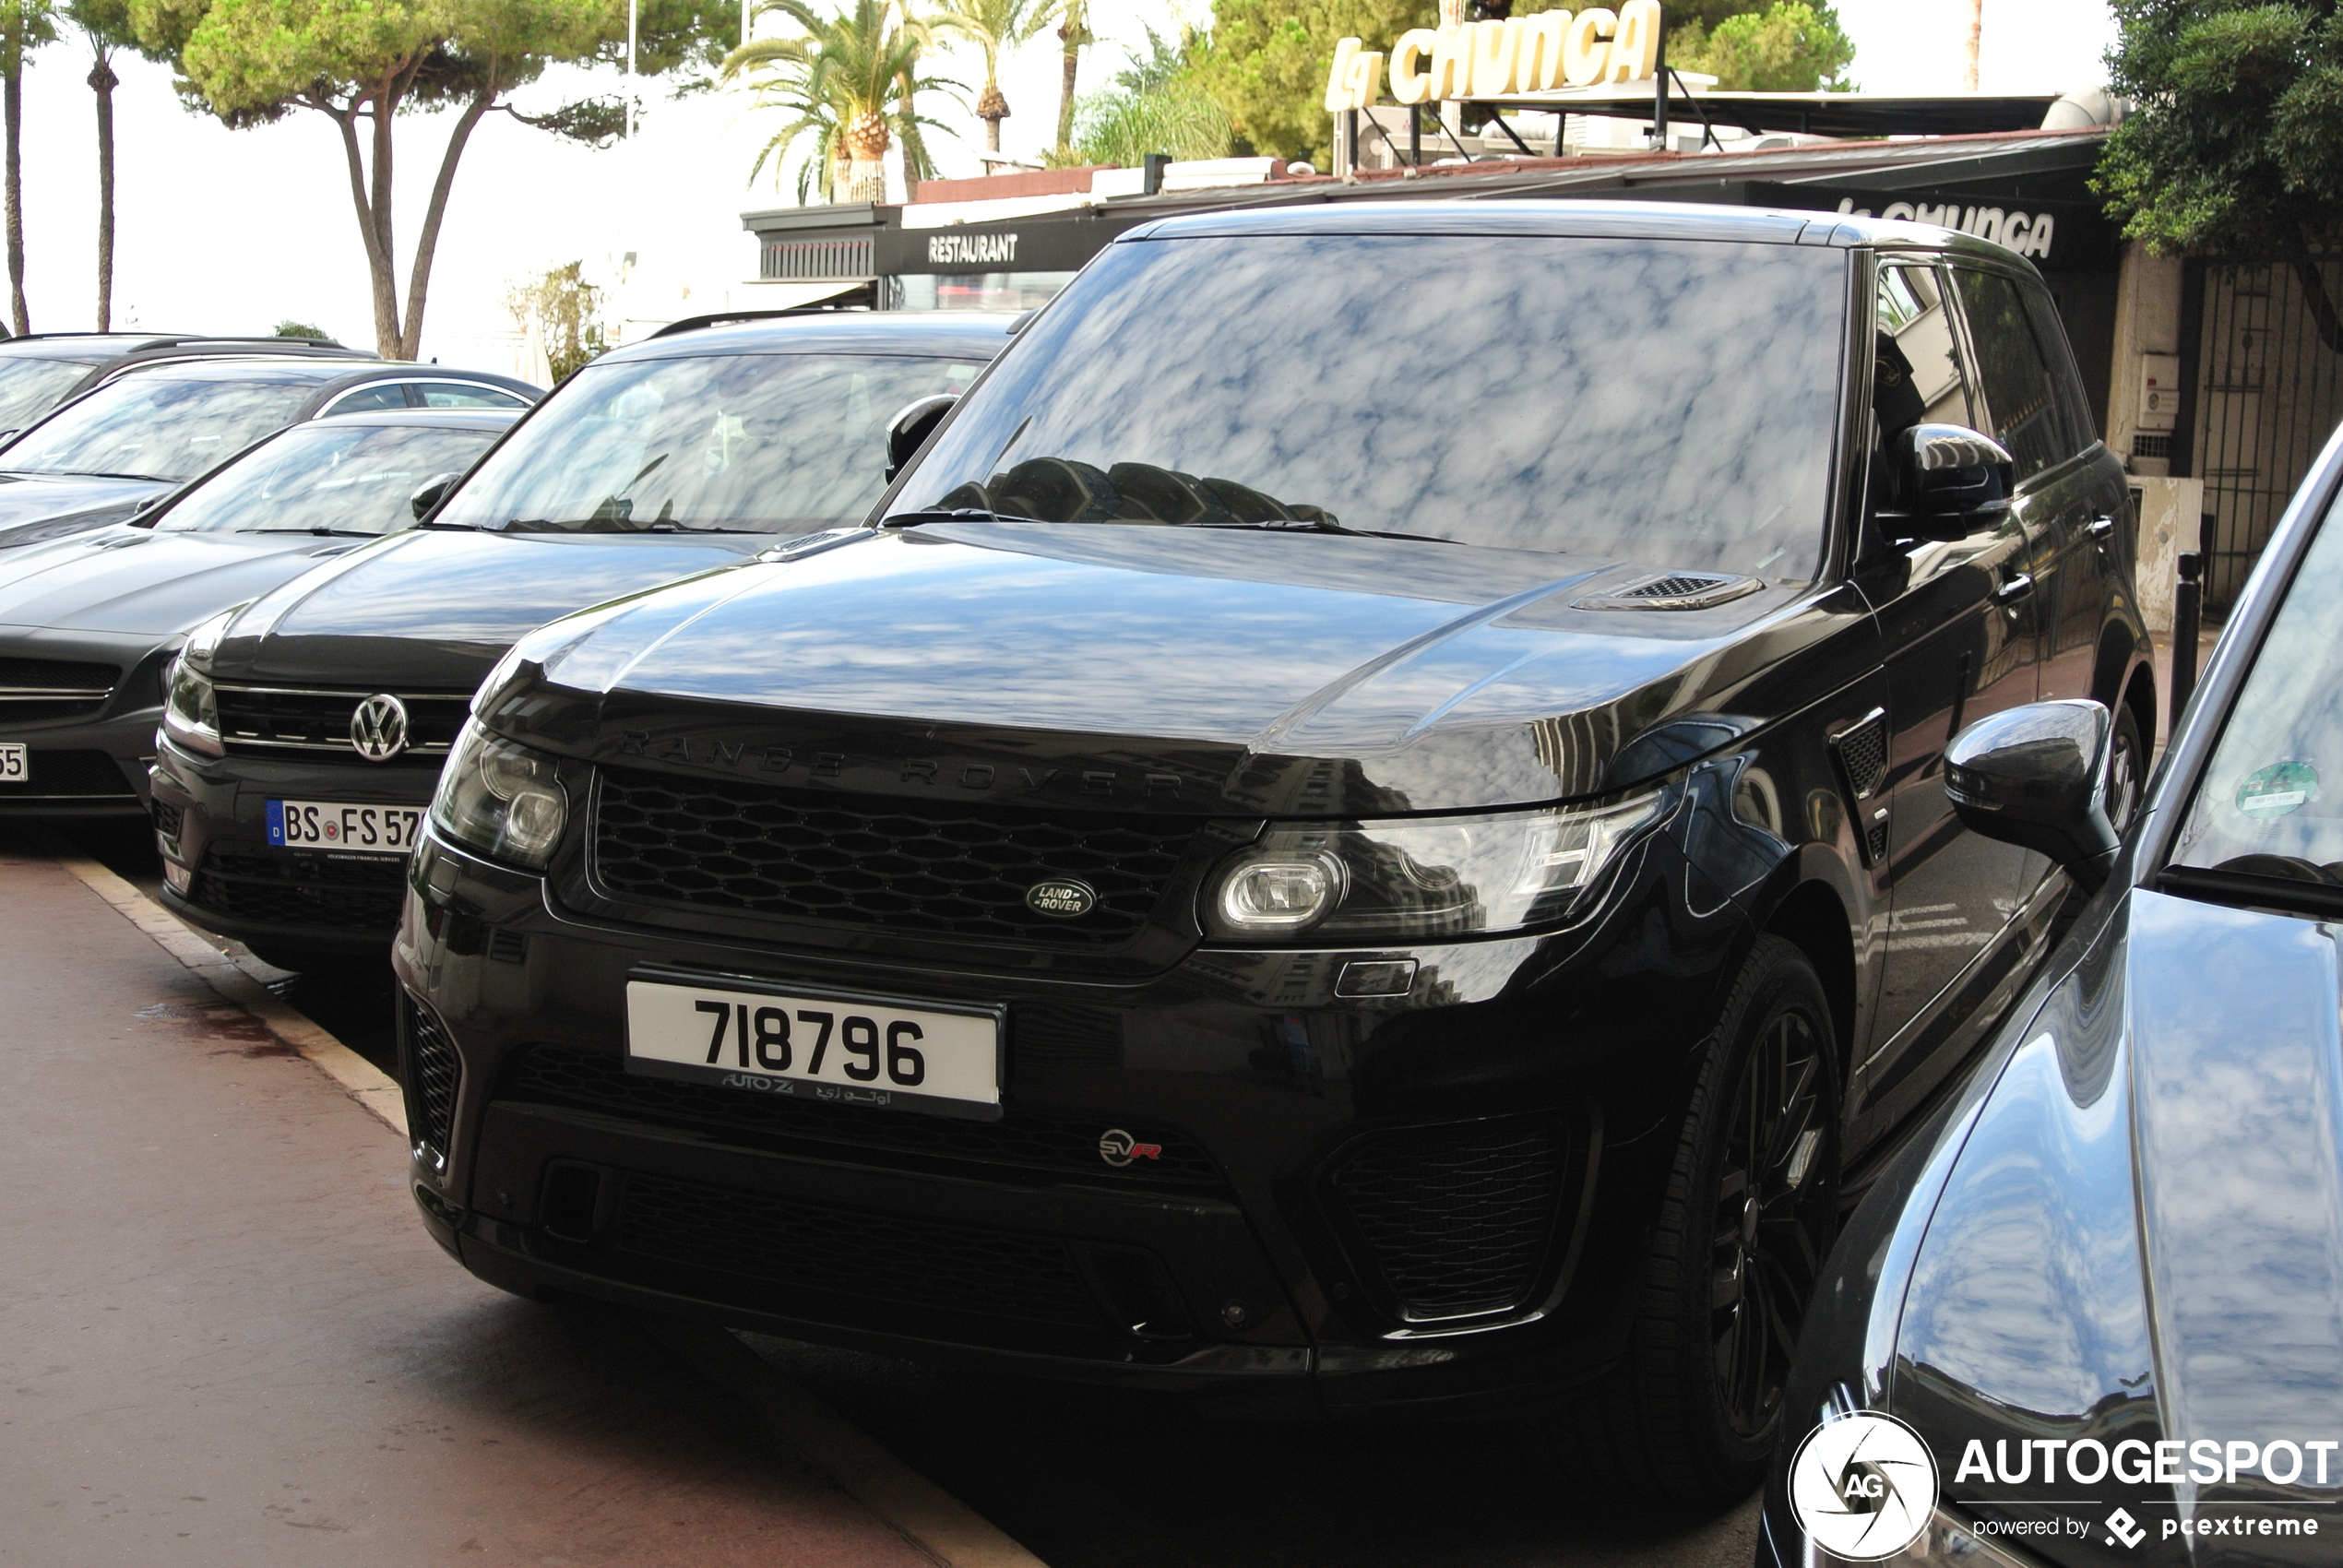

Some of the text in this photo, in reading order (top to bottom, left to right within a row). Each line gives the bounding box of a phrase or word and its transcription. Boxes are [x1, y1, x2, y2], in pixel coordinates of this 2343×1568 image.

[1389, 0, 1660, 104] CHUNCA
[928, 233, 1017, 263] RESTAURANT
[0, 749, 21, 776] 5
[616, 729, 1183, 800] RANGE ROVER
[2266, 766, 2289, 789] 4
[273, 827, 279, 837] D
[285, 805, 426, 847] BS FS 57
[695, 1000, 925, 1087] 718796
[721, 1073, 771, 1090] AUTO
[1100, 1133, 1162, 1164] SVR
